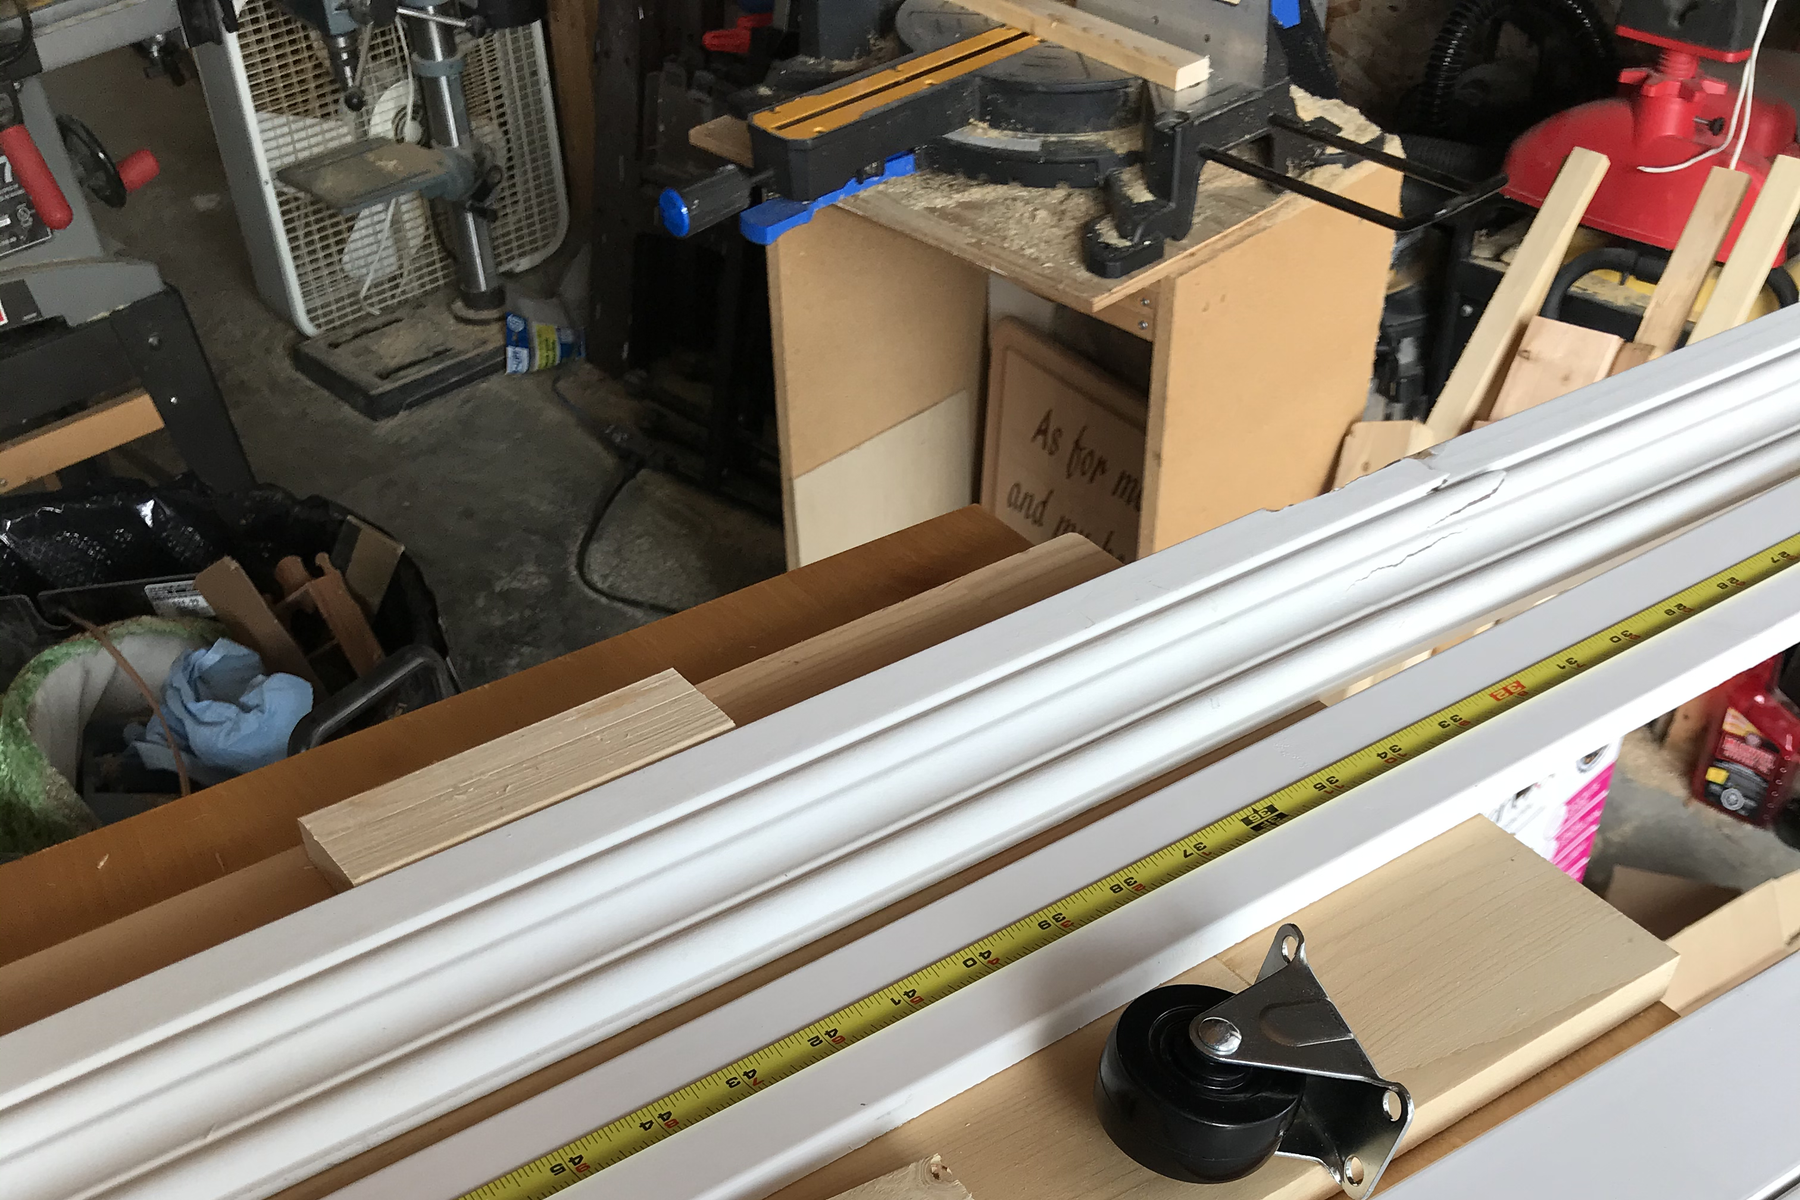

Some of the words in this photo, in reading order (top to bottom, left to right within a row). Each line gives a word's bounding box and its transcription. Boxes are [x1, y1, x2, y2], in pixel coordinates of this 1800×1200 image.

[1030, 408, 1063, 456] As
[1065, 425, 1109, 484] for
[1006, 482, 1055, 528] and
[1770, 551, 1791, 564] 27
[1609, 630, 1633, 643] 30
[1556, 657, 1578, 669] 31
[1492, 682, 1521, 701] 32
[1438, 714, 1463, 729] 33
[1376, 744, 1403, 759] 34
[1313, 776, 1340, 791] 35
[1248, 808, 1272, 822] 36
[1183, 841, 1208, 859] 37
[1109, 876, 1139, 894] 38
[1037, 912, 1067, 931] 39
[962, 949, 993, 969] 40
[889, 988, 918, 1006] 41
[806, 1027, 839, 1048] 42
[724, 1068, 758, 1089] 43
[638, 1110, 673, 1132] 44
[549, 1153, 585, 1176] 45
